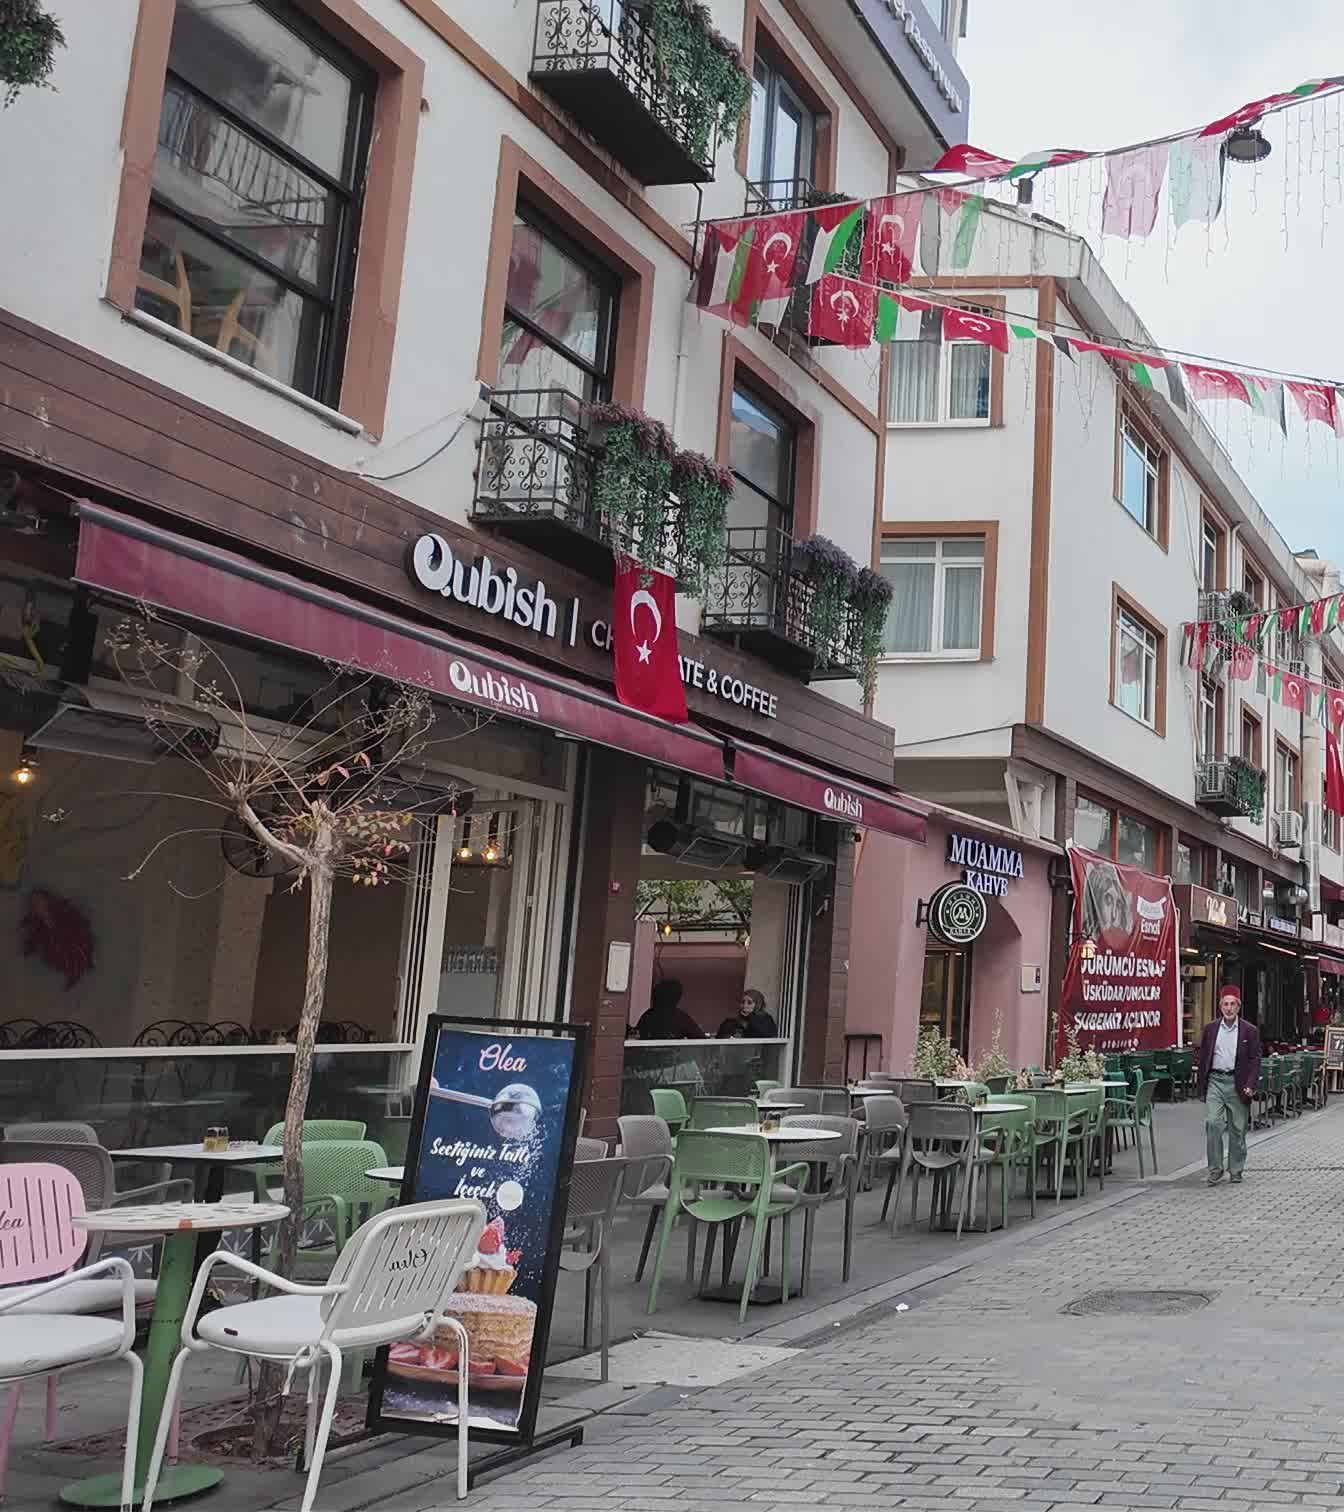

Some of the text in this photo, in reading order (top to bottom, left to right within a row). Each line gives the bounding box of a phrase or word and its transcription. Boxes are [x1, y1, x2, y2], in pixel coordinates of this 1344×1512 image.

[412, 532, 558, 638] Qubish
[706, 669, 719, 694] &
[720, 674, 779, 719] COFFEE
[449, 660, 539, 713] Qubish
[823, 787, 863, 818] Qubish
[950, 834, 1024, 879] MUAMMA
[966, 870, 1008, 896] KAHVE
[479, 1043, 528, 1073] Olea
[471, 1166, 486, 1178] ve
[0, 1210, 24, 1231] lea
